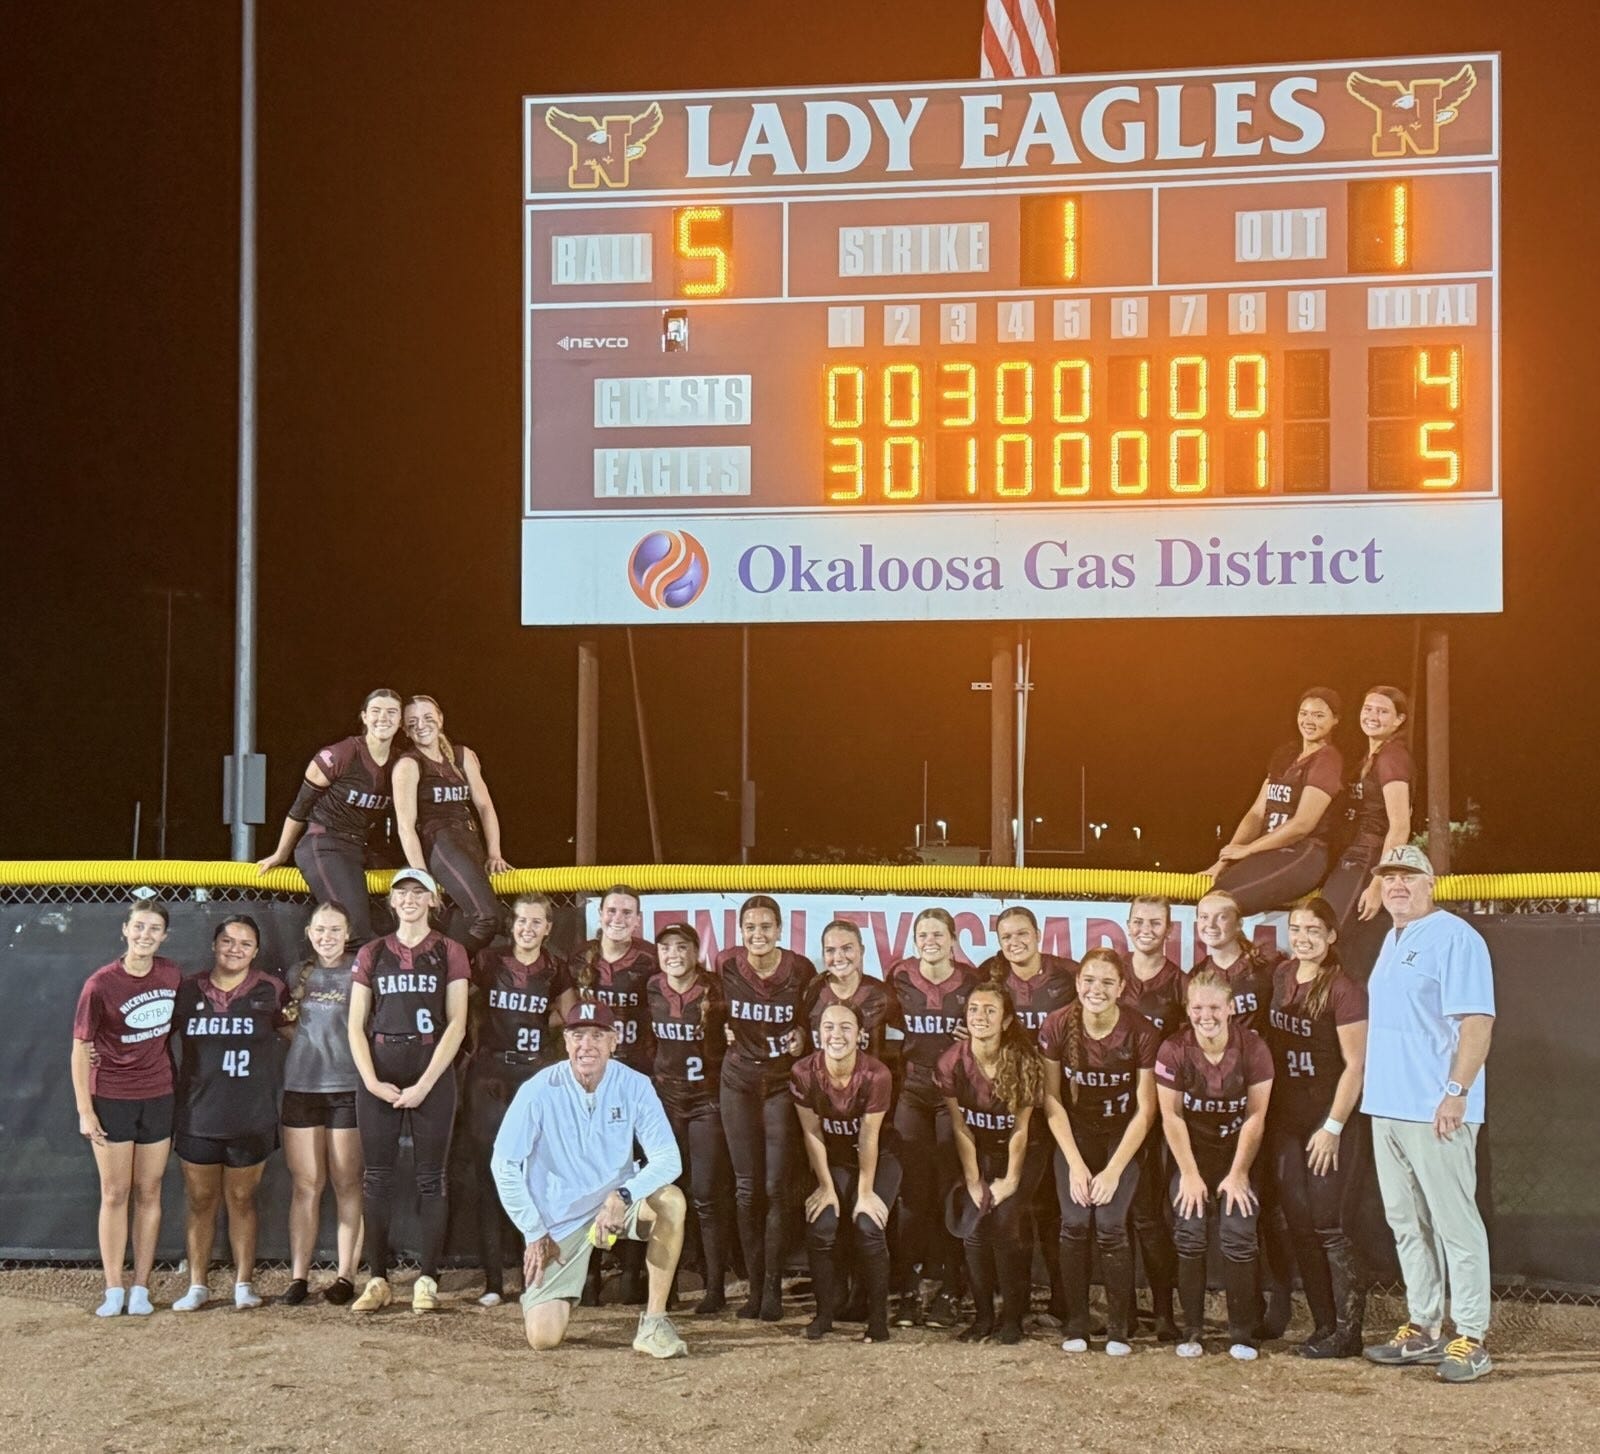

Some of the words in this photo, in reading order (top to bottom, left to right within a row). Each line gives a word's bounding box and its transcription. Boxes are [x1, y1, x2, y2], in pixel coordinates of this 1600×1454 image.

[685, 97, 928, 178] LADY
[960, 76, 1326, 170] EAGLES
[1063, 200, 1077, 279] 1
[1241, 209, 1322, 260] OUT
[1394, 184, 1407, 266] 1
[557, 236, 648, 283] BALL
[678, 207, 727, 295] 5
[844, 224, 985, 275] STRIKE
[839, 309, 855, 344] 1
[895, 306, 910, 344] 2
[950, 305, 967, 343] 3
[1008, 301, 1024, 339] 4
[1064, 300, 1080, 339] 5
[1121, 298, 1138, 336] 6
[1181, 295, 1196, 335] 7
[1239, 294, 1256, 334] 8
[1298, 290, 1315, 330] 9
[1374, 286, 1472, 325] TOTAL
[570, 337, 628, 348] NEVCO
[601, 378, 744, 425] GUESTS
[828, 366, 864, 428] 0
[883, 364, 920, 427] 0
[942, 363, 976, 426] 3
[996, 361, 1032, 425] 0
[1053, 359, 1090, 424] 0
[1139, 360, 1148, 418] 1
[1169, 355, 1207, 420] 0
[1228, 353, 1266, 418] 0
[1418, 350, 1458, 410] 4
[605, 449, 740, 496] EAGLES
[830, 437, 863, 500] 3
[883, 436, 920, 499] 0
[967, 437, 977, 494] 1
[996, 433, 1032, 496] 0
[1053, 432, 1090, 496] 0
[1111, 430, 1148, 495] 0
[1169, 428, 1207, 493] 0
[1257, 430, 1266, 488] 1
[1419, 421, 1460, 488] 5
[738, 543, 1004, 594] Okaloosa
[1023, 540, 1136, 590] Gas
[1155, 533, 1385, 588] District
[1389, 848, 1405, 862] N
[374, 974, 437, 994] EAGLES
[489, 989, 549, 1014] EAGLES
[186, 1017, 254, 1036] EAGLES
[416, 1008, 434, 1034] 6
[579, 1004, 596, 1020] N
[731, 999, 794, 1024] EAGLES
[517, 1028, 541, 1051] 23
[222, 1050, 250, 1077] 42
[686, 1056, 705, 1081] 2
[1287, 1050, 1315, 1077] 24
[1102, 1092, 1130, 1117] 17
